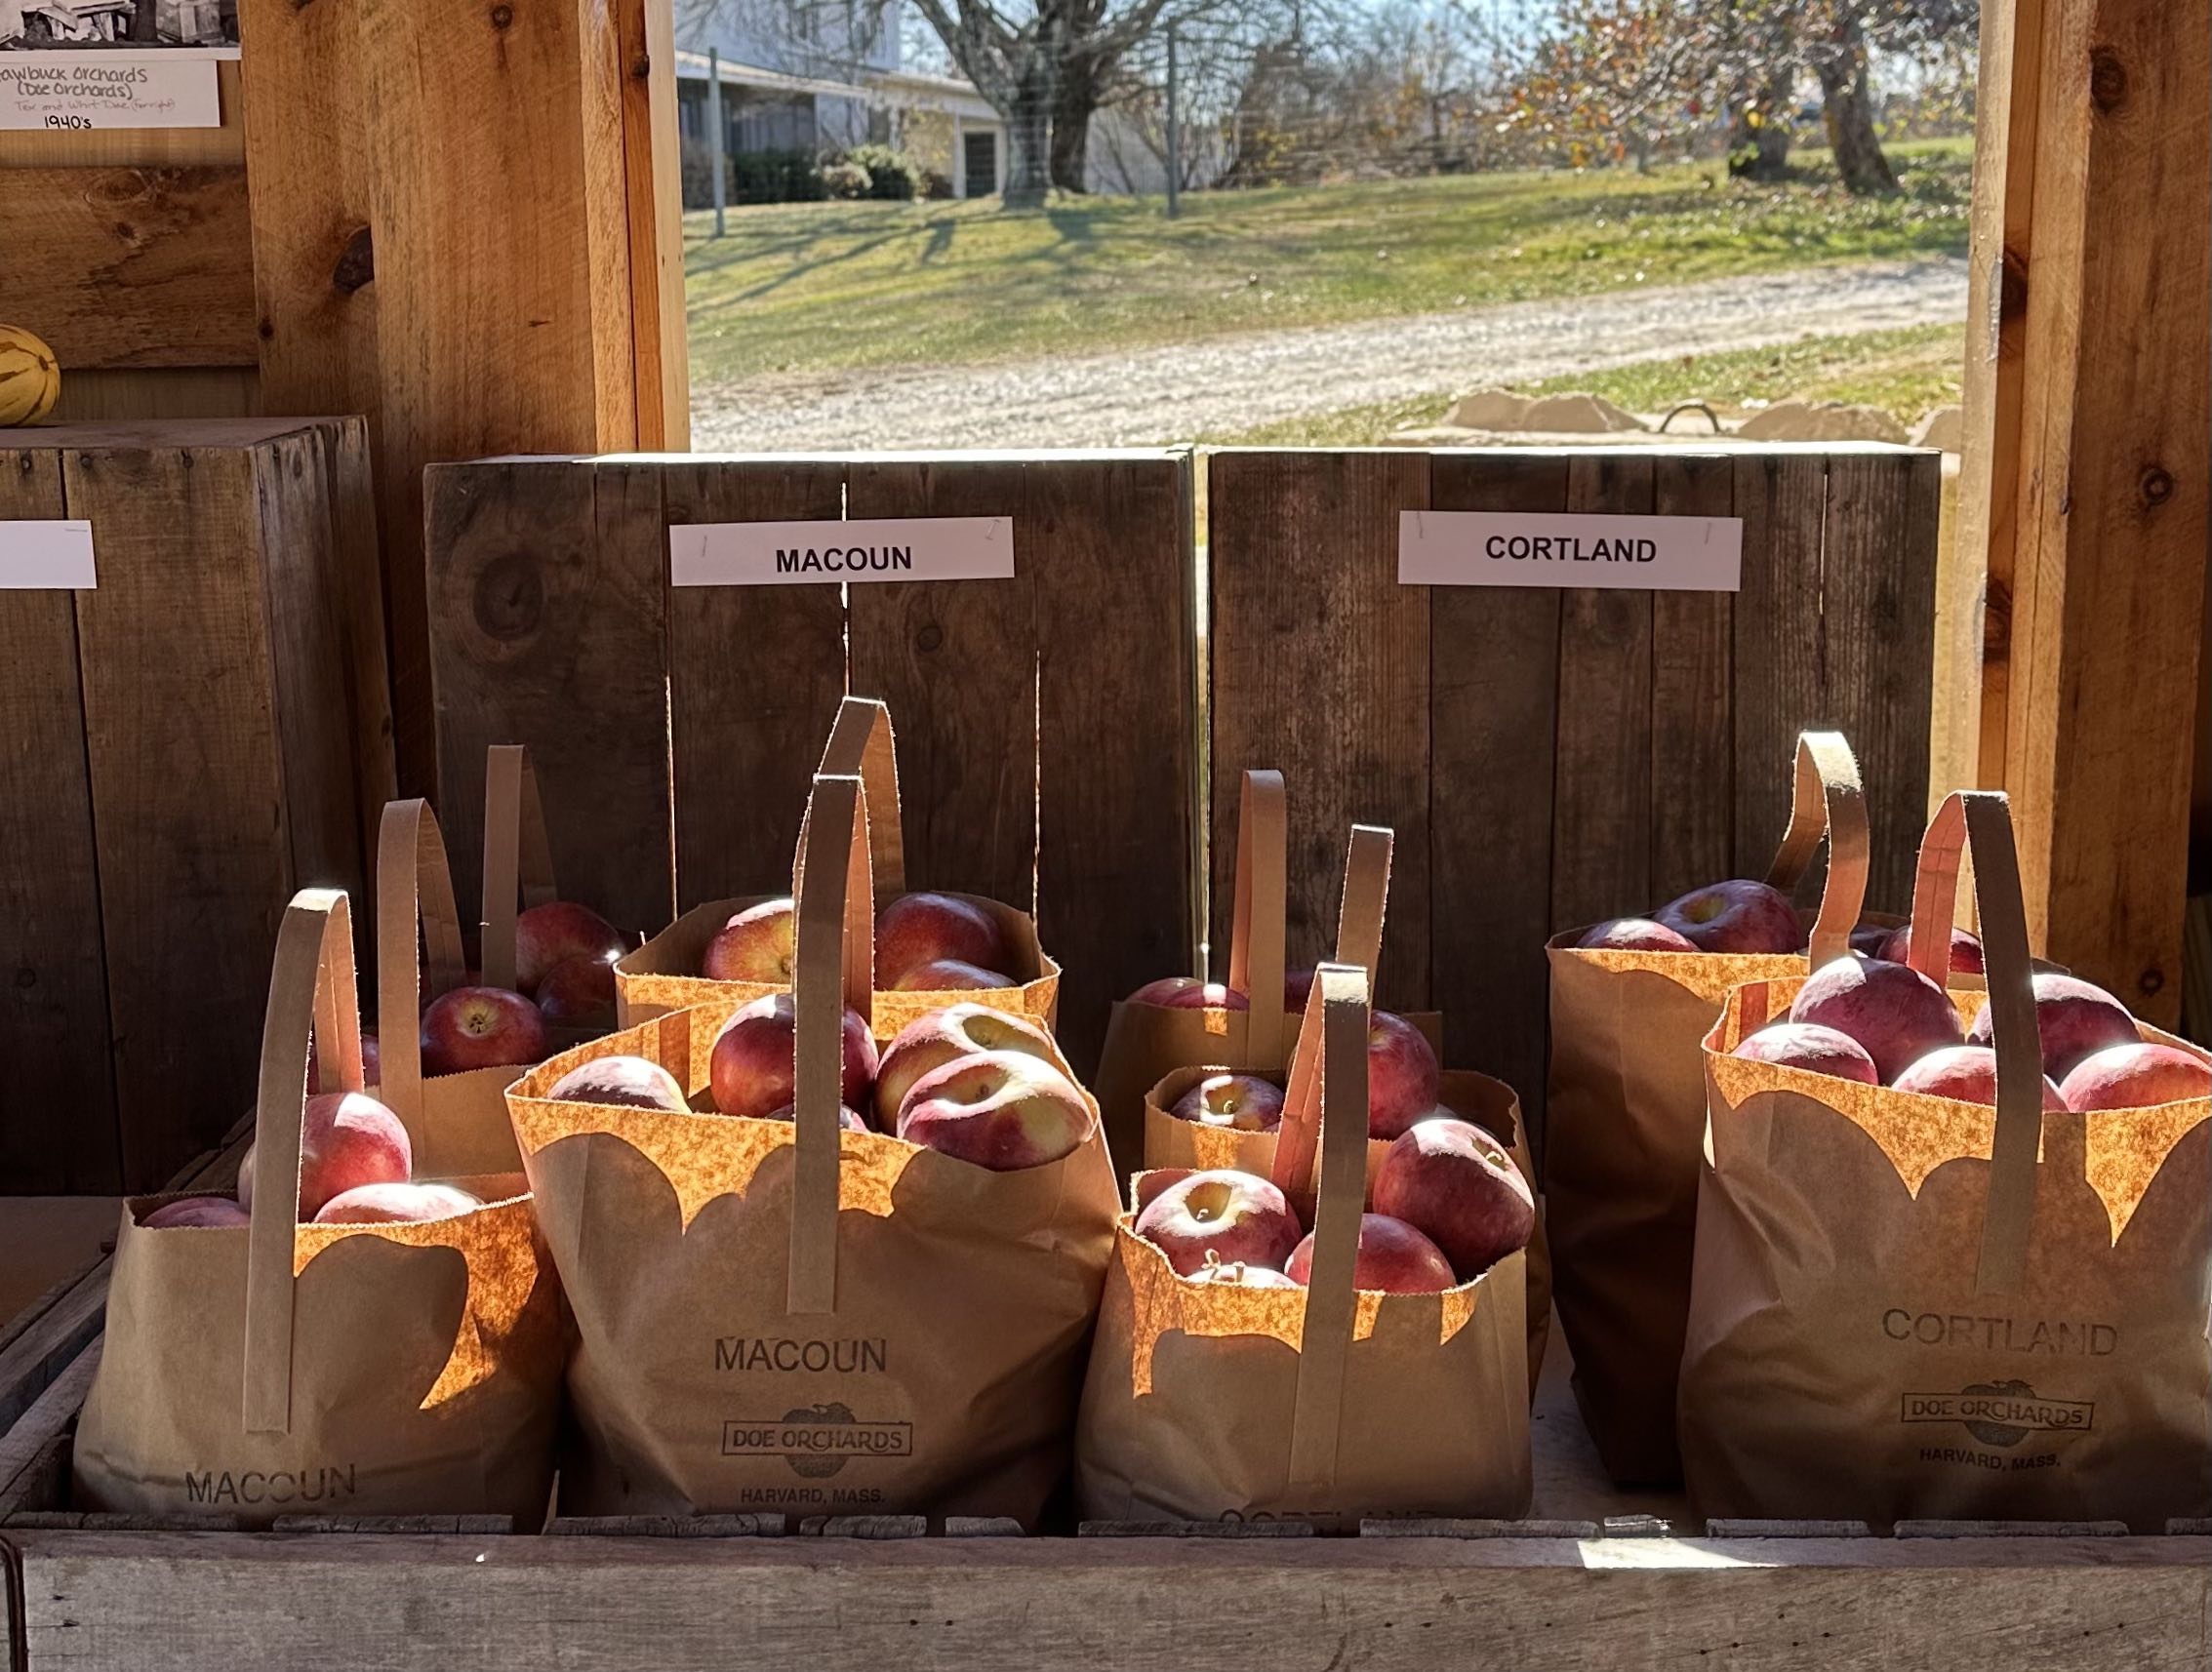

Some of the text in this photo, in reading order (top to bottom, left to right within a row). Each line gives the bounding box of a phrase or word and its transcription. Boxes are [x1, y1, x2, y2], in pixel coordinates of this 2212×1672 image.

[73, 66, 148, 83] Orchards
[18, 81, 134, 100] (Doe Orchards)
[45, 115, 92, 129] 1940's
[776, 546, 912, 573] MACOUN
[1485, 536, 1657, 563] CORTLAND
[1882, 1308, 2118, 1356] CORTLAND
[714, 1337, 887, 1373] MACOUN
[1911, 1400, 2083, 1428] DOE ORCHARDS
[733, 1429, 903, 1453] DOE ORCHARDS
[1919, 1449, 2062, 1472] HARVARD, MASS.
[185, 1463, 356, 1504] MACOUN
[741, 1488, 886, 1505] HARVARD, MASS.
